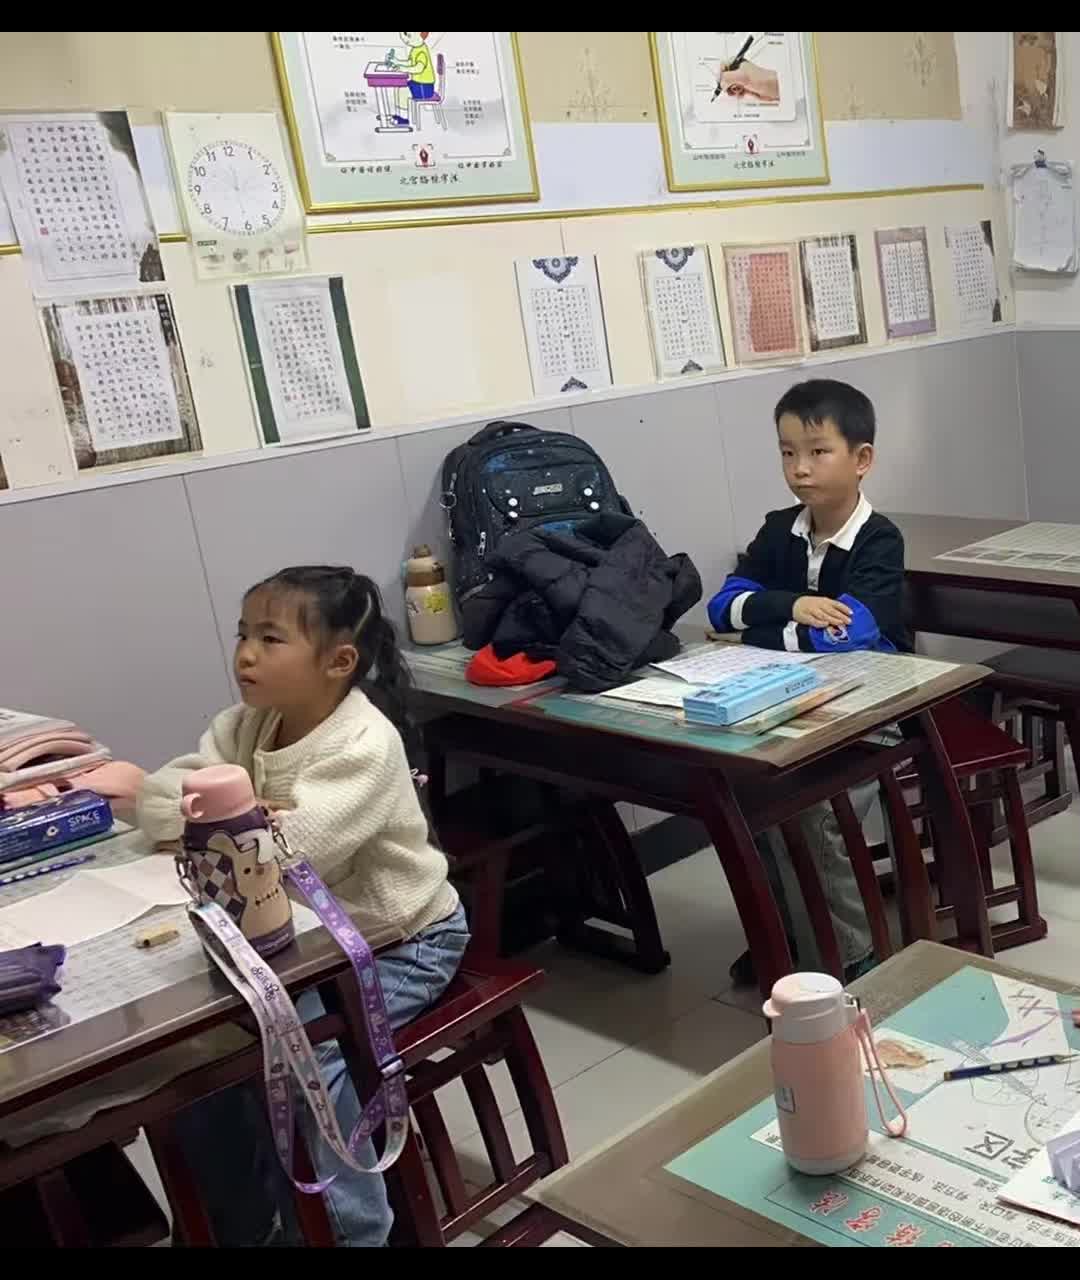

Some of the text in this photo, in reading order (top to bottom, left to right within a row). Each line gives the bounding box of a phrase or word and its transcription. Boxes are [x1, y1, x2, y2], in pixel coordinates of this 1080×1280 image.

[207, 150, 217, 162] 11
[223, 145, 234, 157] 12
[248, 149, 254, 161] 1
[194, 166, 206, 177] 10
[263, 163, 271, 176] 2
[194, 184, 201, 195] 9
[272, 182, 279, 193] 3
[204, 203, 212, 215] 8
[272, 200, 279, 209] 4
[221, 216, 229, 231] 7
[245, 220, 253, 231] 6
[262, 214, 270, 225] 5
[808, 1189, 955, 1247] 练字法
